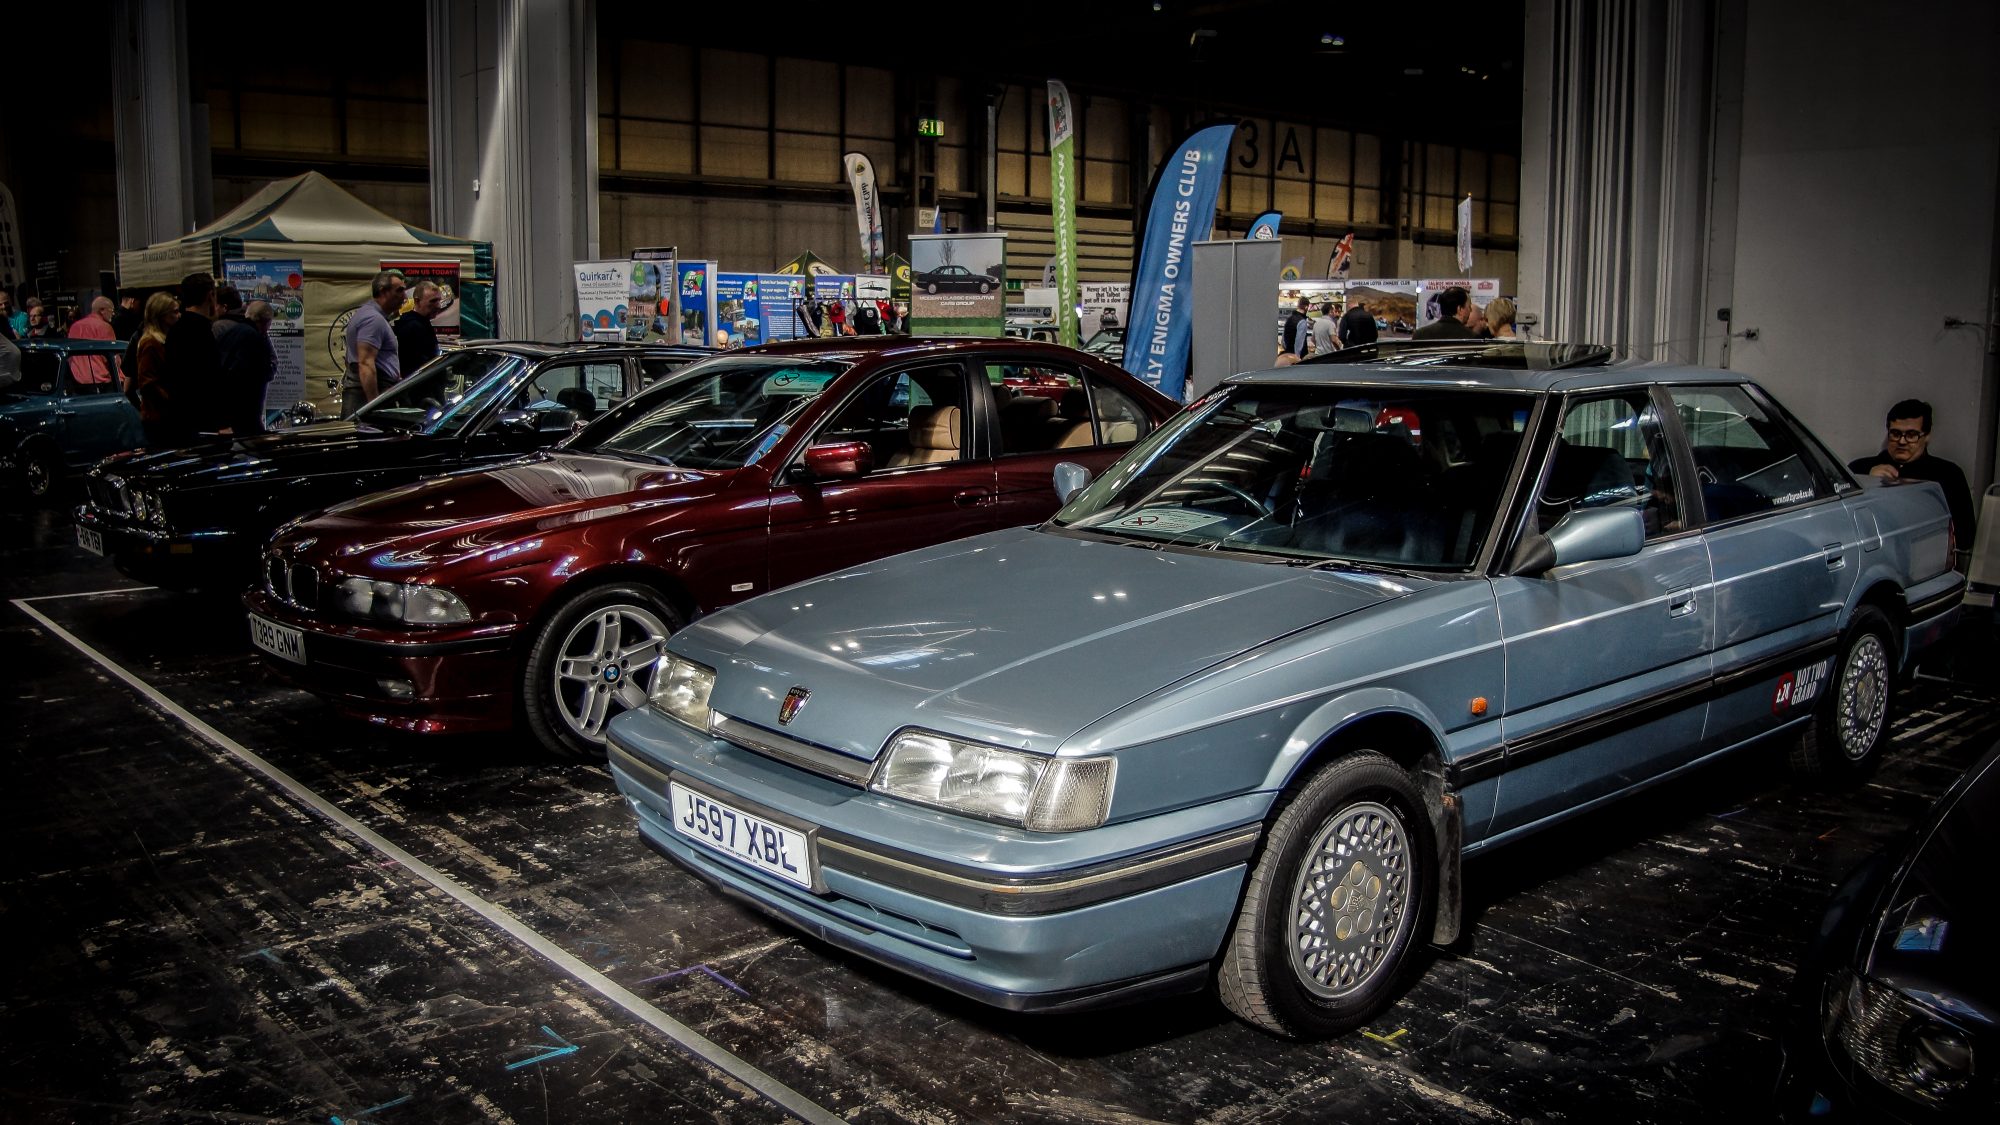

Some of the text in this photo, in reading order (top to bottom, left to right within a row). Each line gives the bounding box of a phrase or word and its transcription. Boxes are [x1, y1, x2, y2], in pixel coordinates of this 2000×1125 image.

[1239, 120, 1304, 173] 3 A
[1150, 284, 1176, 355] ENIGMA
[1164, 201, 1191, 279] OWNERS
[1178, 150, 1200, 196] CLUB
[276, 629, 300, 659] GNM
[1791, 681, 1817, 705] GRAND
[684, 795, 798, 874] J597 XBL
